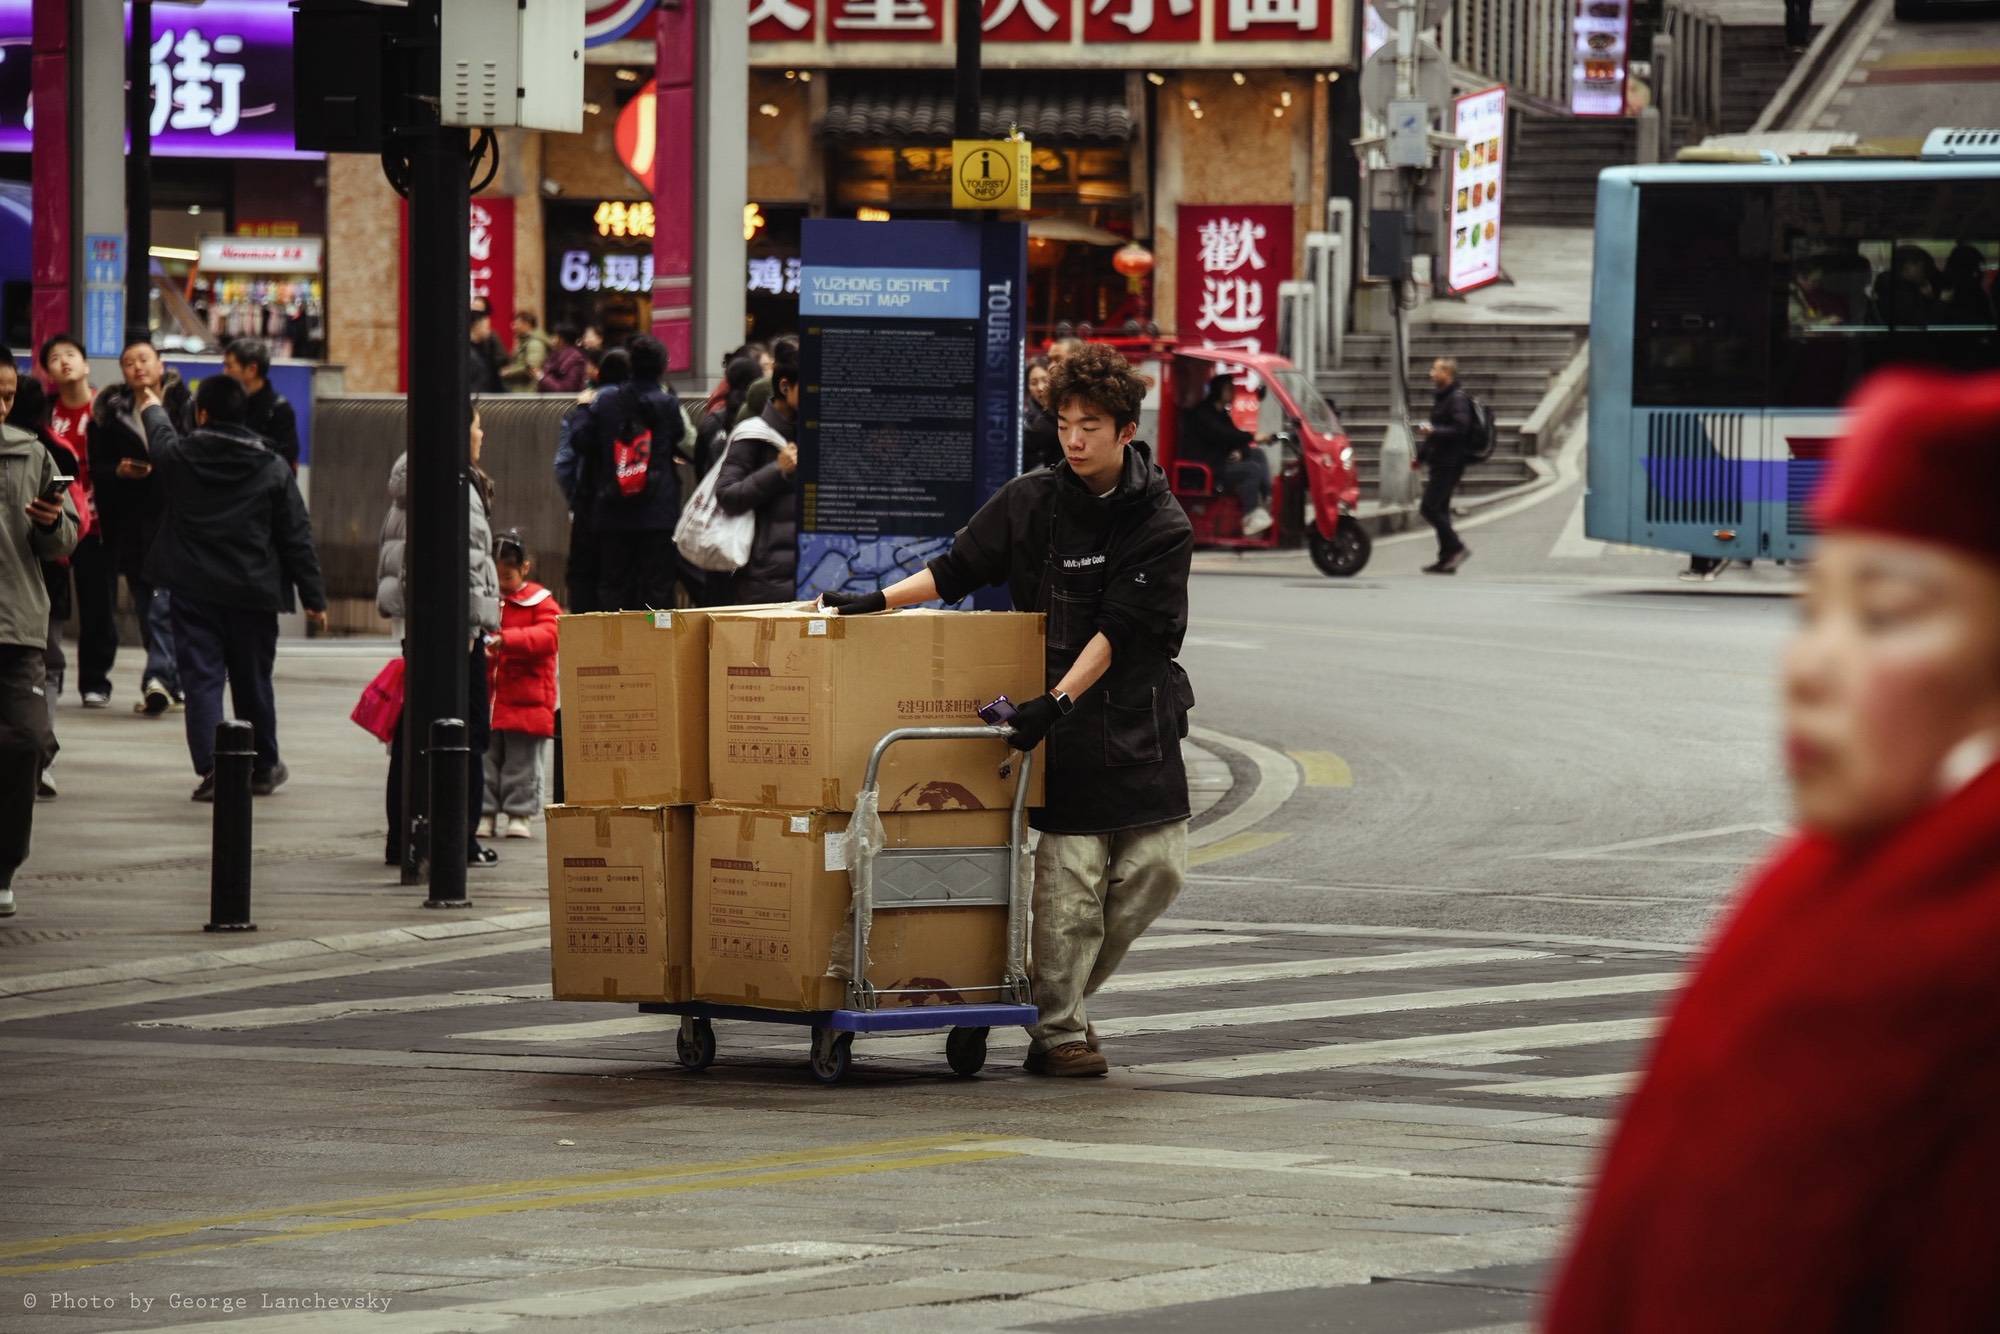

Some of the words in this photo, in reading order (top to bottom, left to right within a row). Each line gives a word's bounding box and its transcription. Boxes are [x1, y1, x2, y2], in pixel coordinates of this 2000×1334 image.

[966, 180, 1005, 188] TOURIST
[974, 188, 997, 197] INFO
[812, 276, 882, 291] YUZHONG
[886, 278, 950, 293] DISTRICT
[812, 292, 872, 306] TOURIST
[878, 294, 911, 307] MAP
[987, 280, 1012, 382] TOURIST
